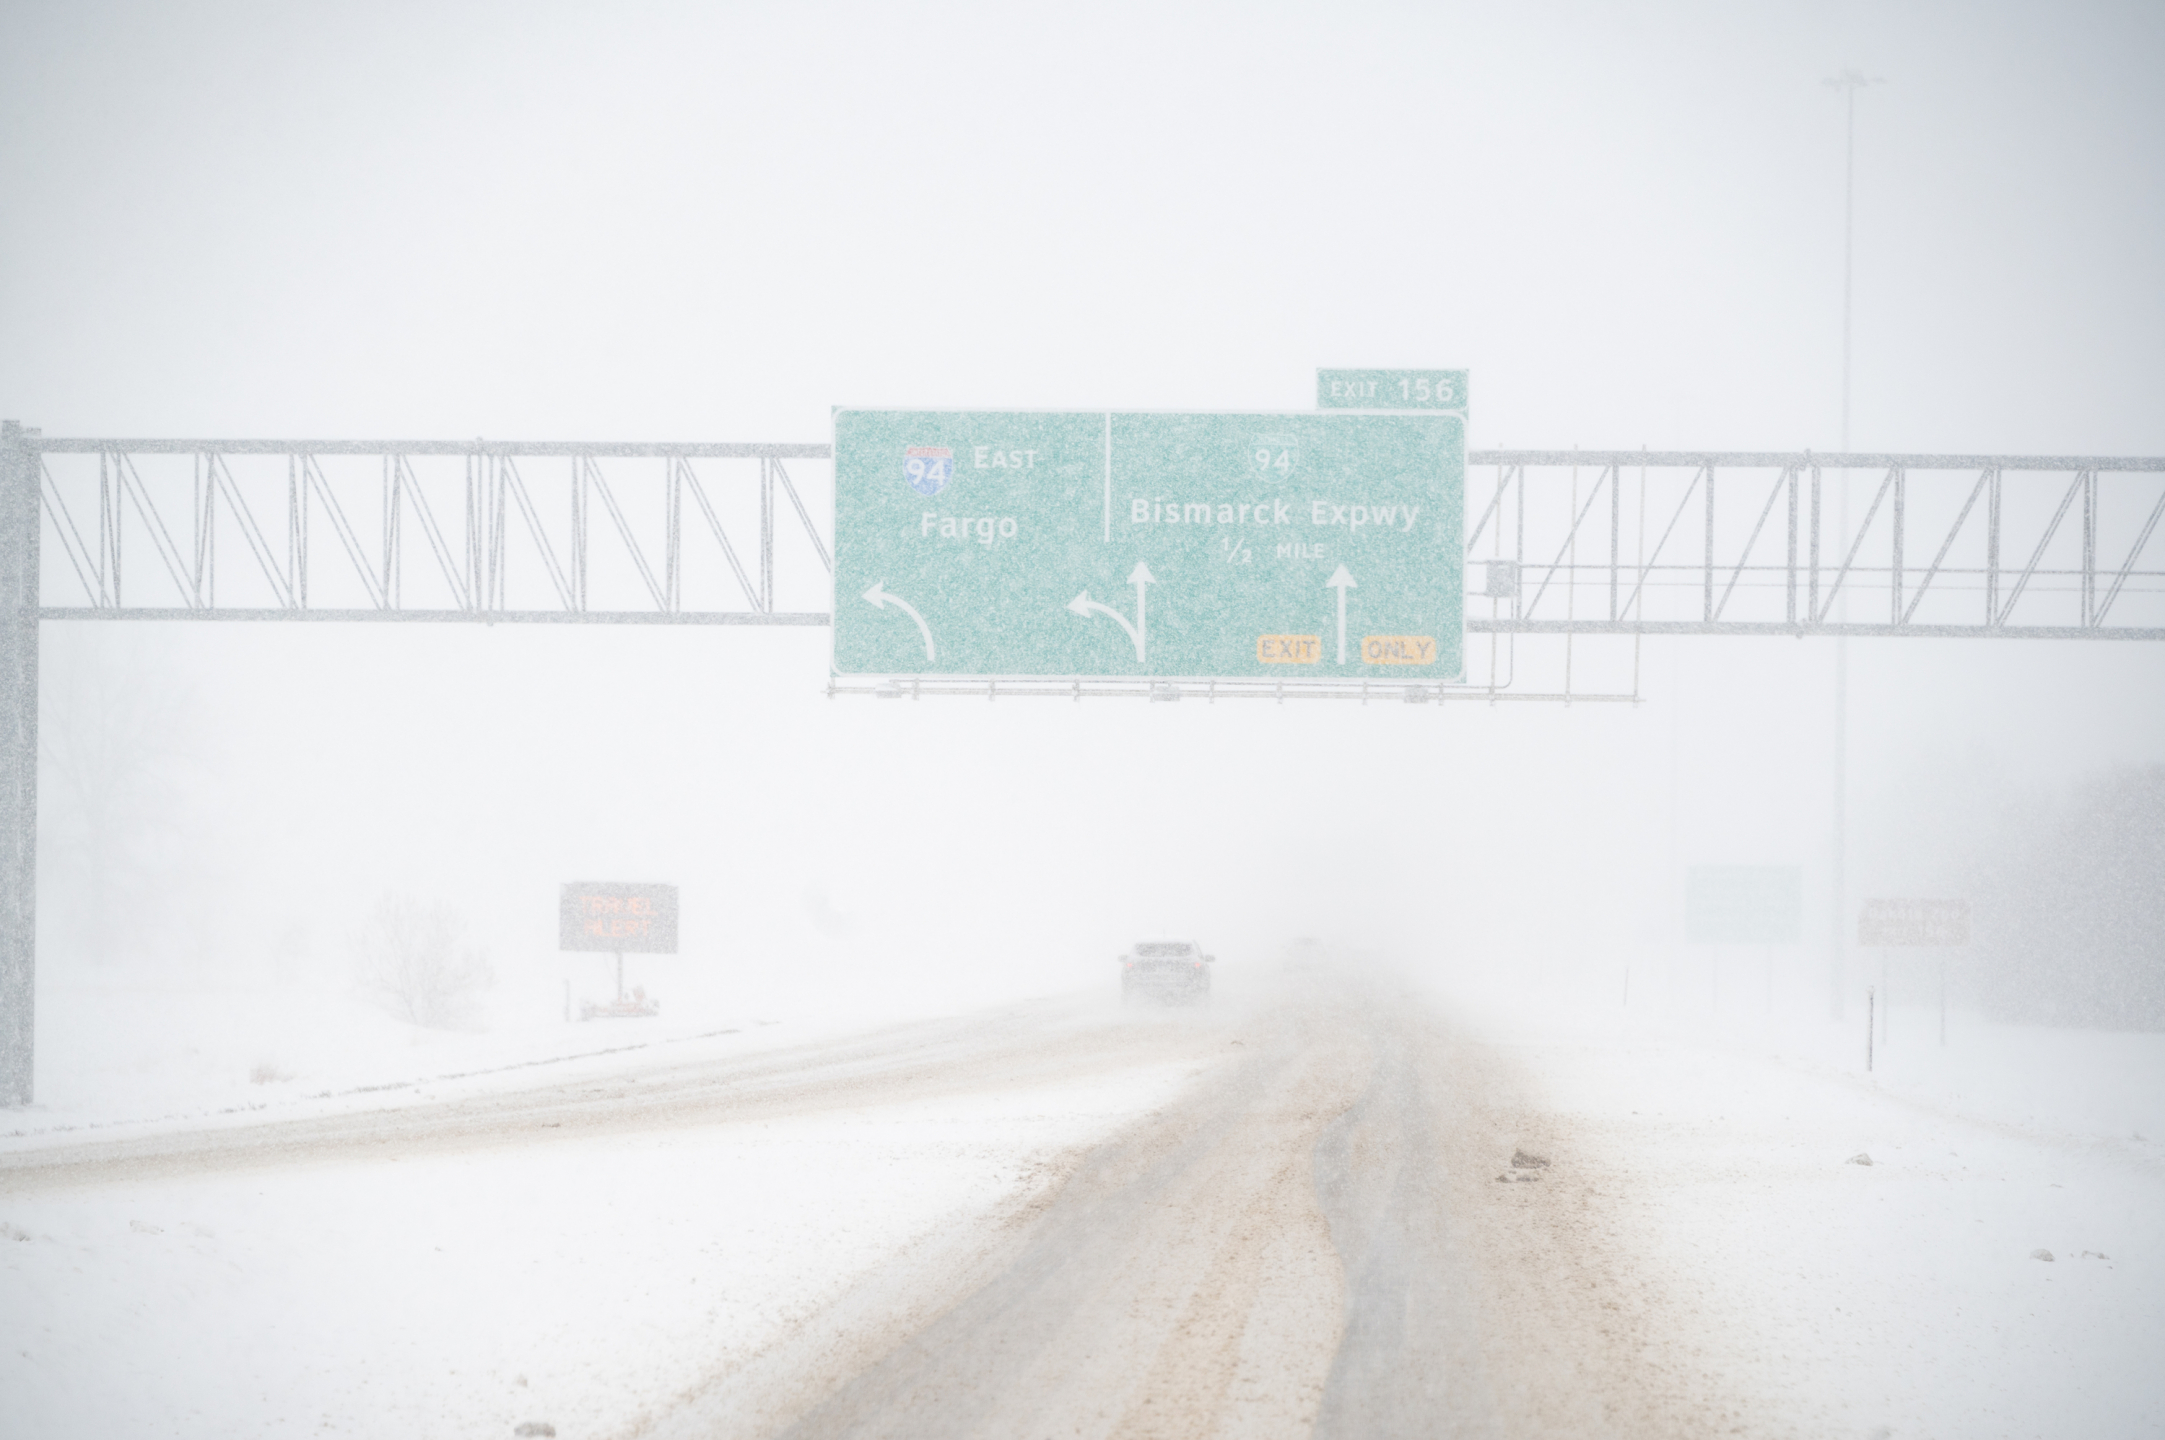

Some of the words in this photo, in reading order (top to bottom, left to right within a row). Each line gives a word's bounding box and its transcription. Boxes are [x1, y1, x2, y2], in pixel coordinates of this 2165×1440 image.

[1331, 380, 1378, 397] EXIT
[1398, 378, 1453, 401] 156
[906, 458, 946, 485] 94
[1254, 449, 1291, 472] 94
[1131, 498, 1291, 525] Bismarck
[1311, 500, 1420, 533] Expwy
[921, 511, 1018, 545] Fargo
[1276, 542, 1325, 559] MILE
[1261, 639, 1316, 658] EXIT
[1367, 640, 1431, 660] ONLY
[579, 895, 658, 916] TRAVEL
[583, 918, 652, 937] ALERT
